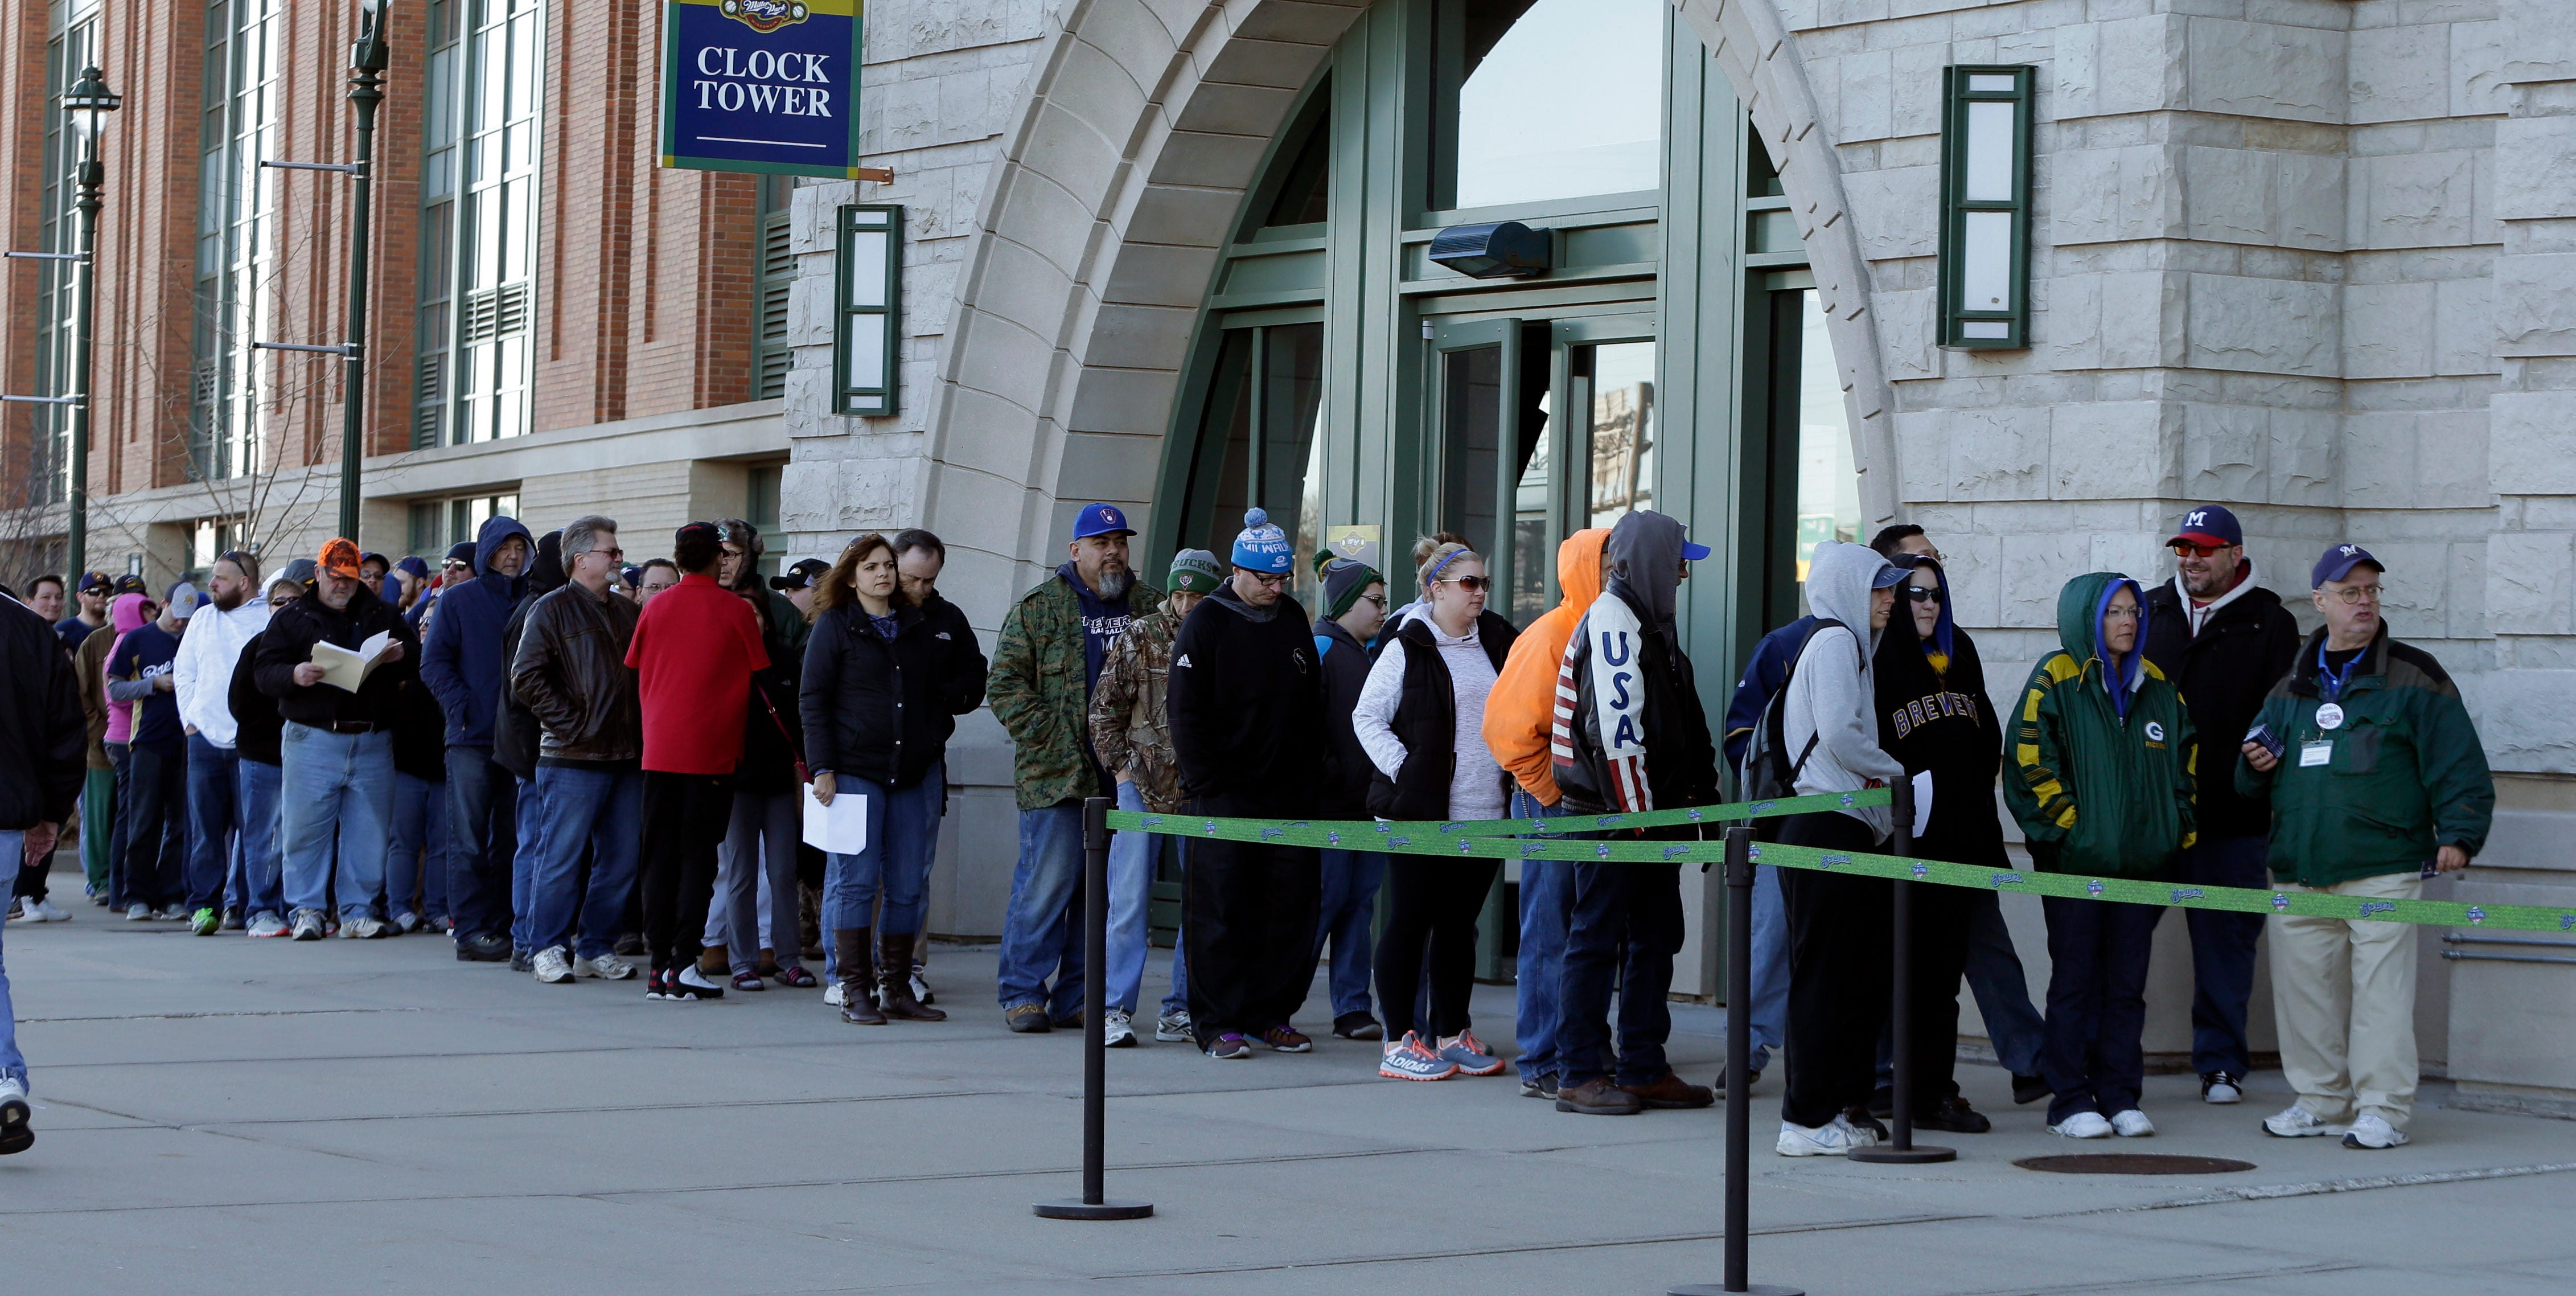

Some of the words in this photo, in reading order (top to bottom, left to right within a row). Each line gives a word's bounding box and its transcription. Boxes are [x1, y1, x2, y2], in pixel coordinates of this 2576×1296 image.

[765, 3, 787, 15] Park
[751, 19, 778, 28] WISCONSIN
[697, 46, 830, 83] CLOCK
[693, 80, 832, 117] TOWER
[2185, 511, 2208, 527] M
[2339, 544, 2359, 558] M
[1173, 559, 1213, 573] BUCKS
[1091, 626, 1124, 635] BASBALL
[1601, 631, 1641, 749] USA
[2145, 721, 2164, 741] G
[1385, 1055, 1435, 1073] ADIDAS
